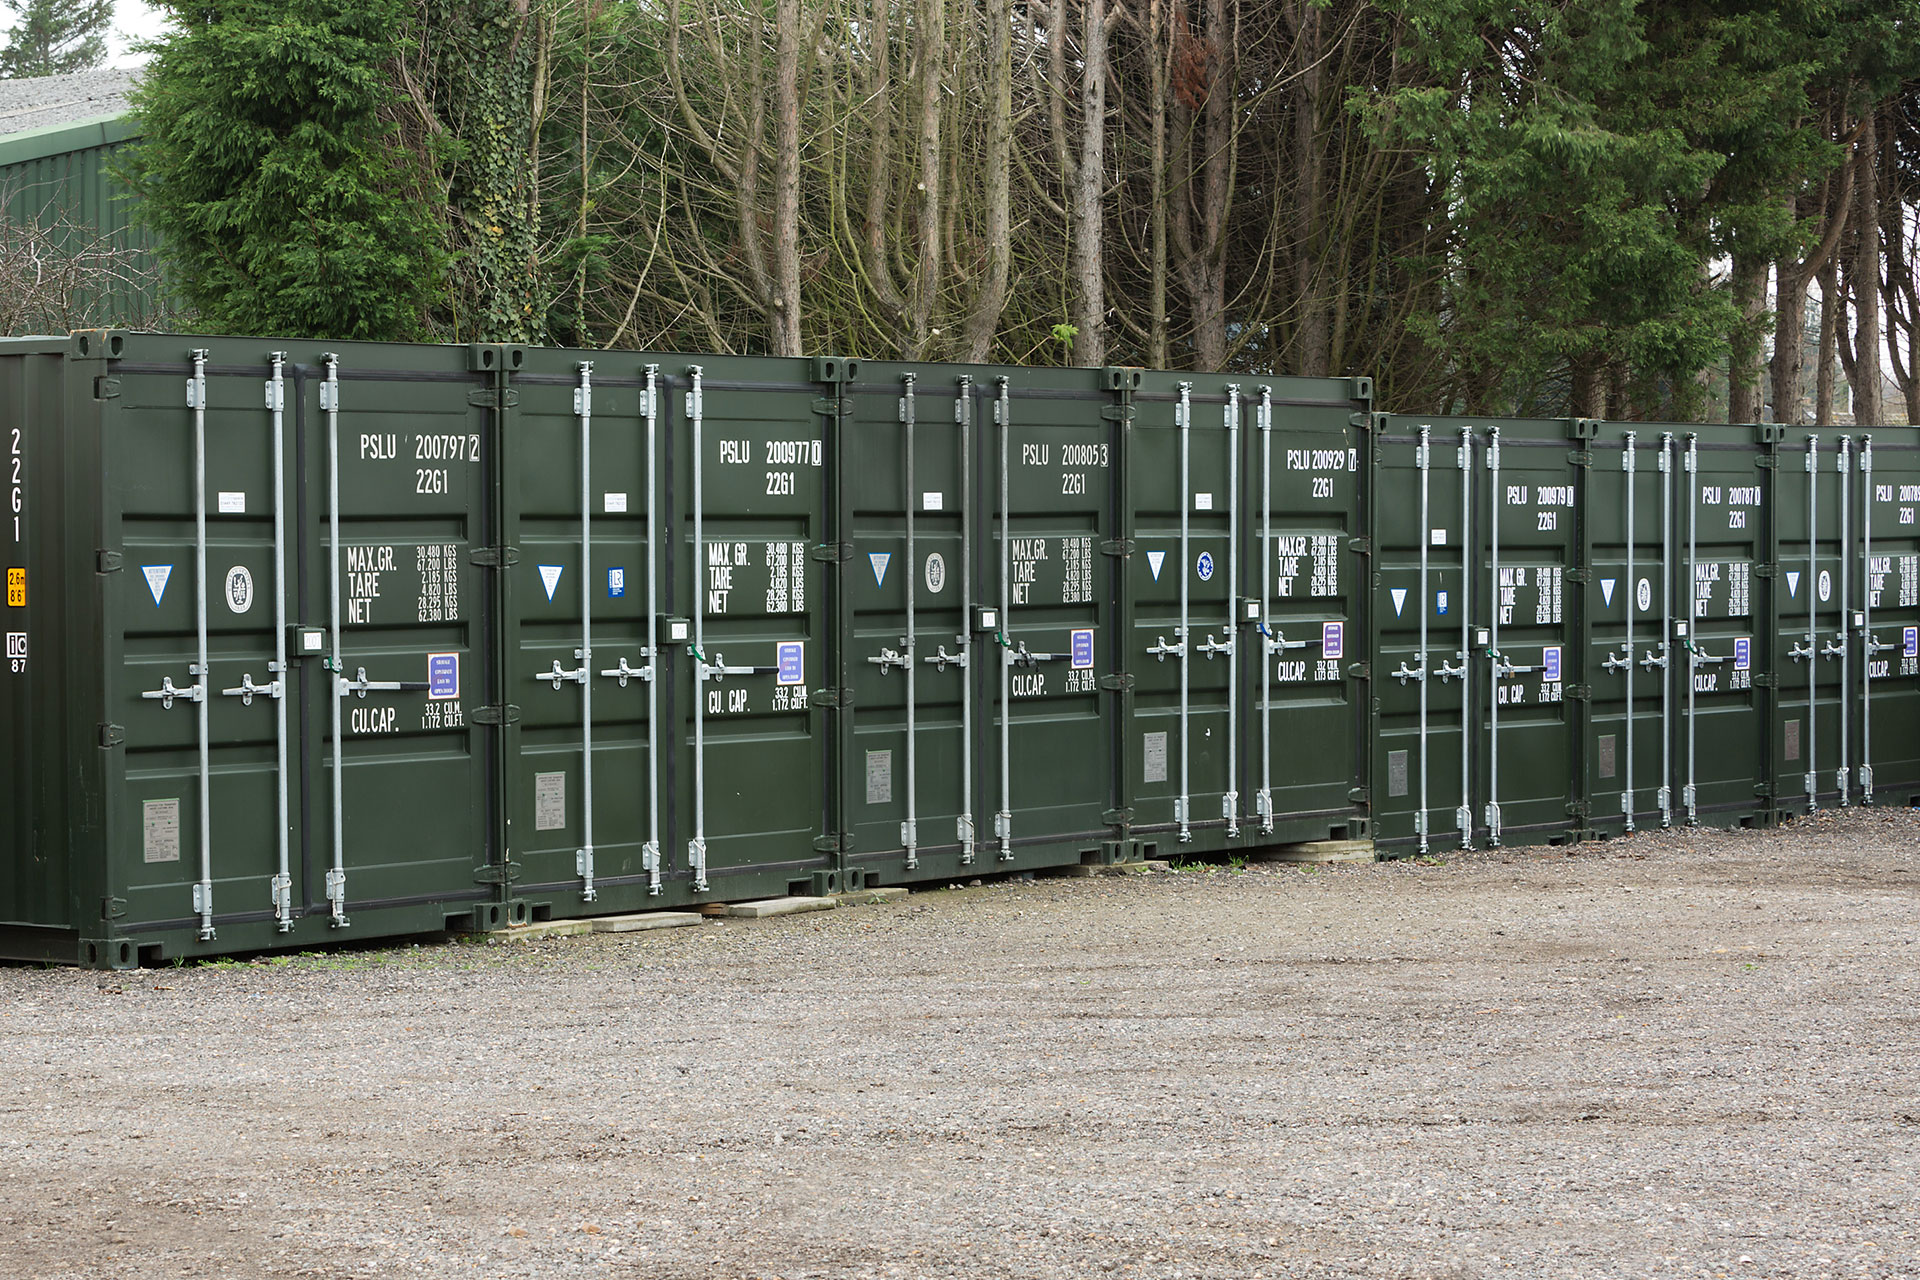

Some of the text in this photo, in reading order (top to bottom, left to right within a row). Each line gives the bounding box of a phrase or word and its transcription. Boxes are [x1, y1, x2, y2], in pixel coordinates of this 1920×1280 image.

[361, 434, 396, 459] PSLU
[720, 440, 749, 463] PSLU
[1023, 444, 1048, 465] PSLU
[1288, 450, 1309, 469] PSLU
[416, 469, 447, 493] 22G1
[766, 472, 794, 495] 22G1
[1063, 474, 1085, 494] 22G1
[1313, 478, 1333, 497] 22G1
[1507, 486, 1527, 504] PSLU
[1703, 487, 1720, 504] PSLU
[1876, 485, 1892, 502] PSLU
[1538, 512, 1556, 530] 22G1
[1729, 511, 1745, 528] 22G1
[1900, 507, 1914, 524] 22G1
[348, 547, 397, 571] MAX.GR.
[444, 545, 457, 557] KGS
[1013, 539, 1048, 560] MAX.GR.
[444, 558, 457, 570] LBS
[1013, 561, 1035, 582] TARE
[1279, 557, 1299, 576] TARE
[348, 573, 380, 597] TARE
[444, 570, 457, 582] KGS
[709, 567, 732, 591] TARE
[1870, 574, 1884, 590] TARE
[444, 583, 457, 595] LBS
[1013, 583, 1029, 604] NET
[1279, 577, 1293, 596] NET
[1500, 587, 1515, 605] TARE
[1696, 582, 1712, 598] TARE
[349, 598, 371, 623] NET
[445, 596, 458, 608] KGS
[709, 590, 728, 613] NET
[1696, 599, 1707, 616] NET
[445, 608, 459, 620] LBS
[1500, 606, 1513, 624] NET
[12, 659, 25, 672] 87
[1013, 674, 1046, 696] CU.CAP.
[425, 703, 441, 716] 33.2
[352, 708, 399, 733] CU.CAP.
